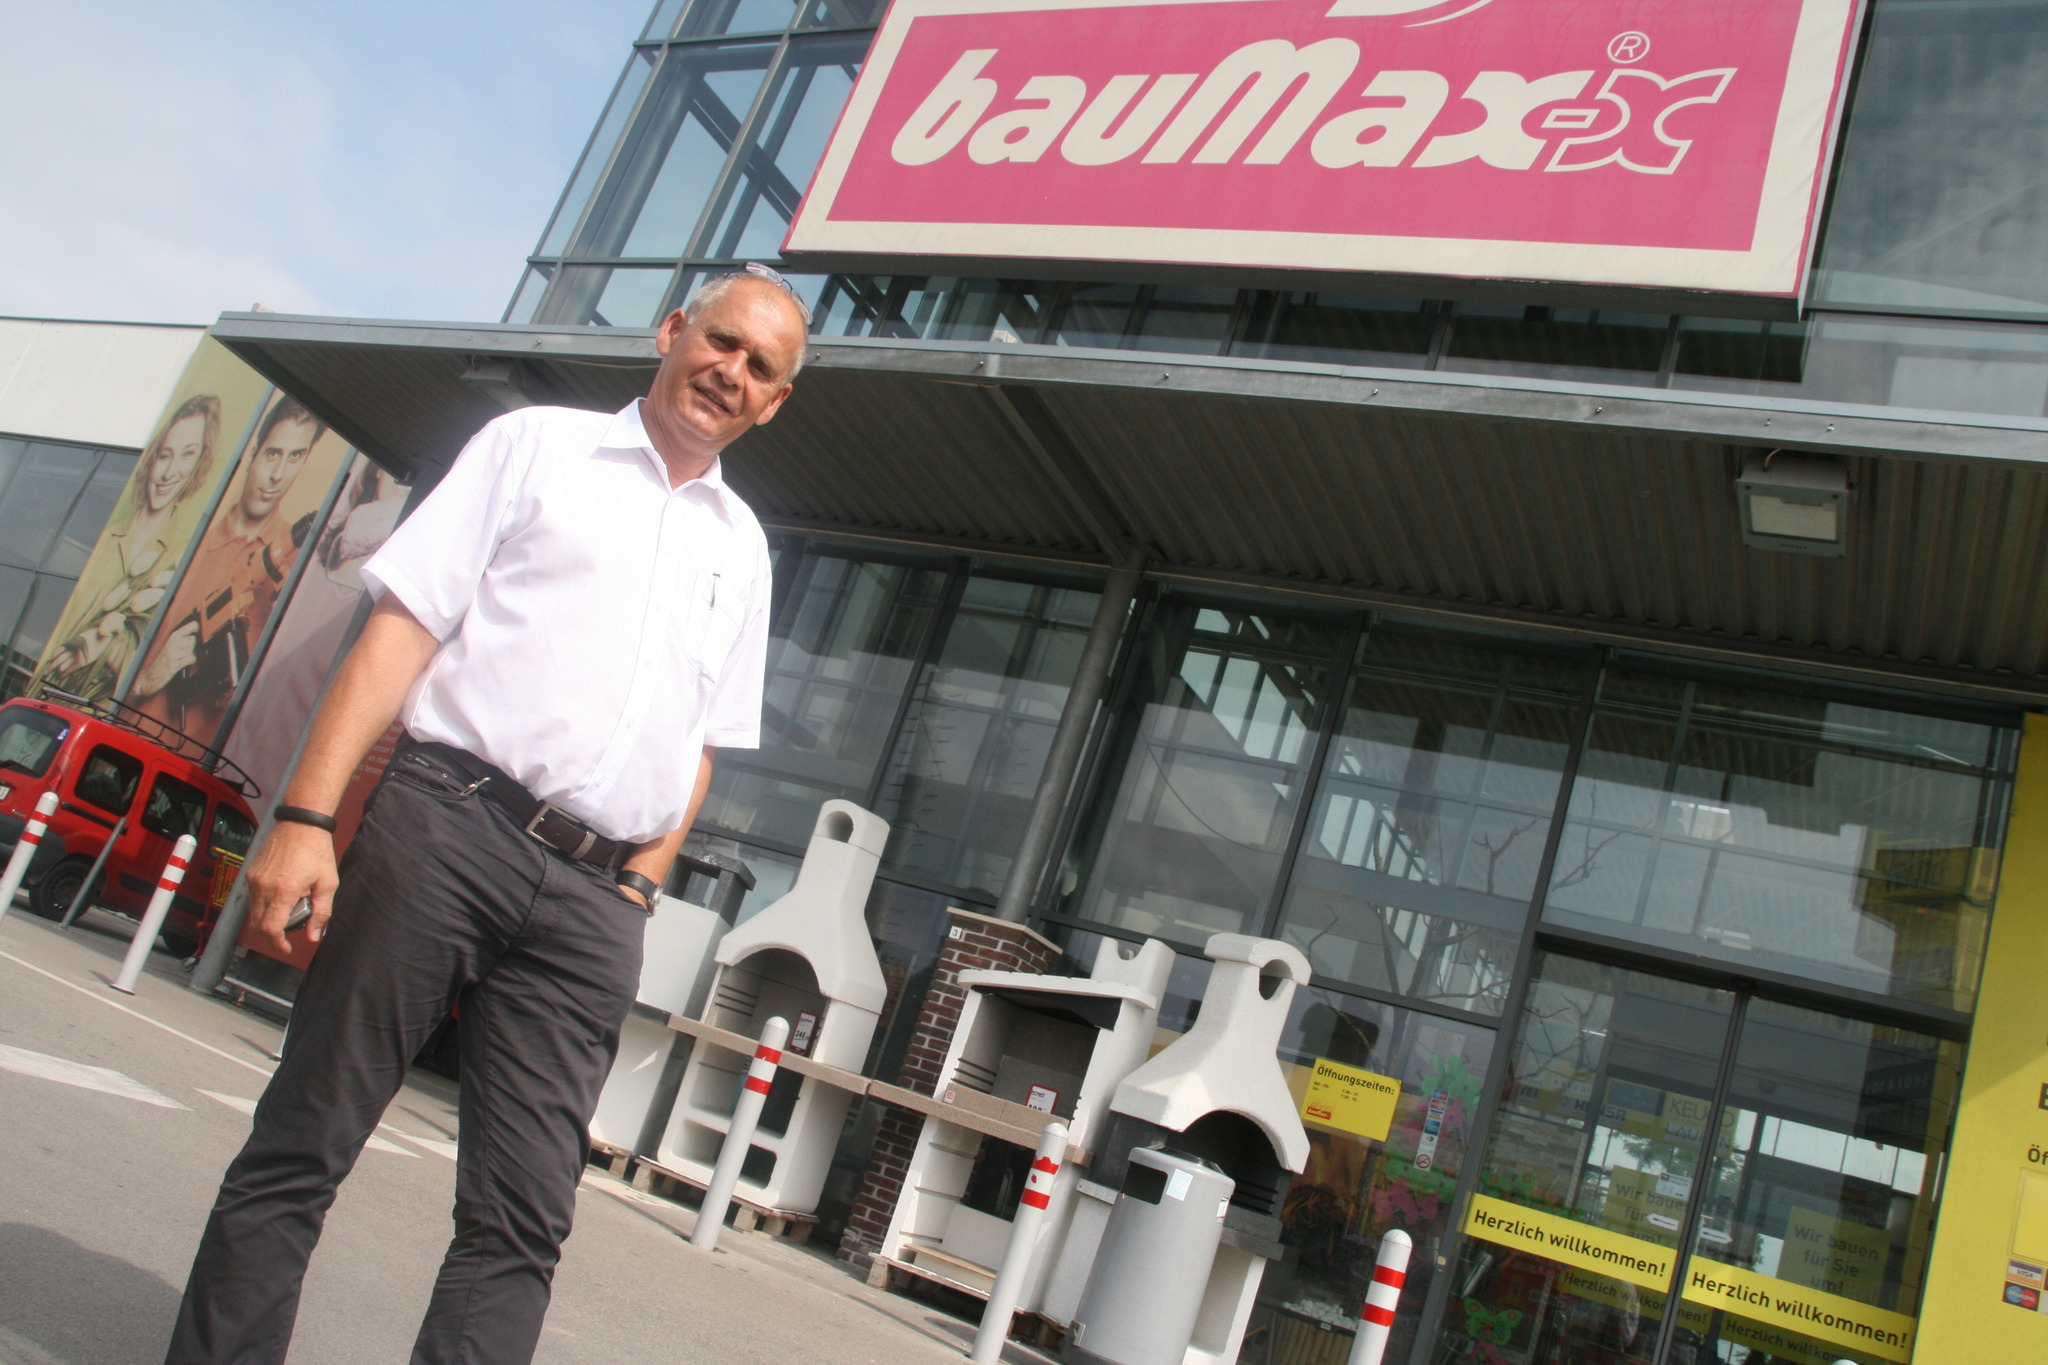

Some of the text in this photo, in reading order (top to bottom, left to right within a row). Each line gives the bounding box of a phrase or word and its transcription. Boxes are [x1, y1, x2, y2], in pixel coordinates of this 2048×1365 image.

[1317, 1064, 1395, 1095] Öffnungszeiten:
[1616, 1183, 1642, 1201] Wir
[1647, 1190, 1687, 1213] baue
[1474, 1209, 1666, 1277] Herzlich willkommen!
[1794, 1224, 1879, 1260] Wir bauen
[1804, 1248, 1860, 1277] für Sie
[2017, 1268, 2033, 1278] VISA
[1564, 1271, 1617, 1297] Herzlich
[1692, 1272, 1908, 1348] Herzlich willkommen!
[1725, 1319, 1784, 1347] Herzlich
